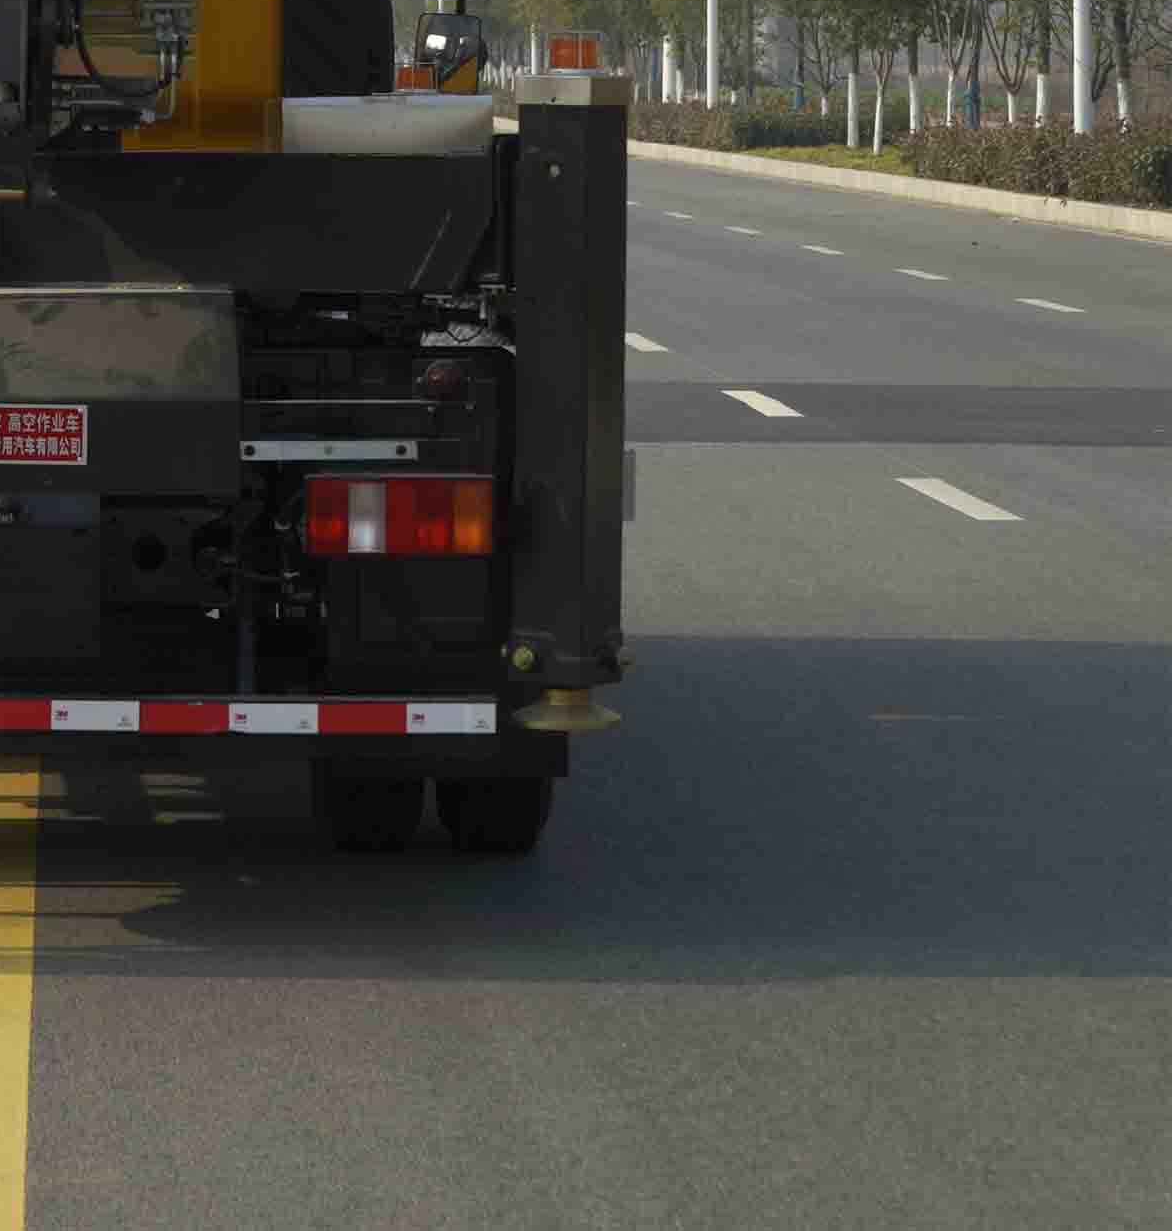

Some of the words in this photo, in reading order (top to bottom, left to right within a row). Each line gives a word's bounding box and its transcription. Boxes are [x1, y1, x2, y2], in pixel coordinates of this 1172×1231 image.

[8, 413, 80, 433] 高空作业车
